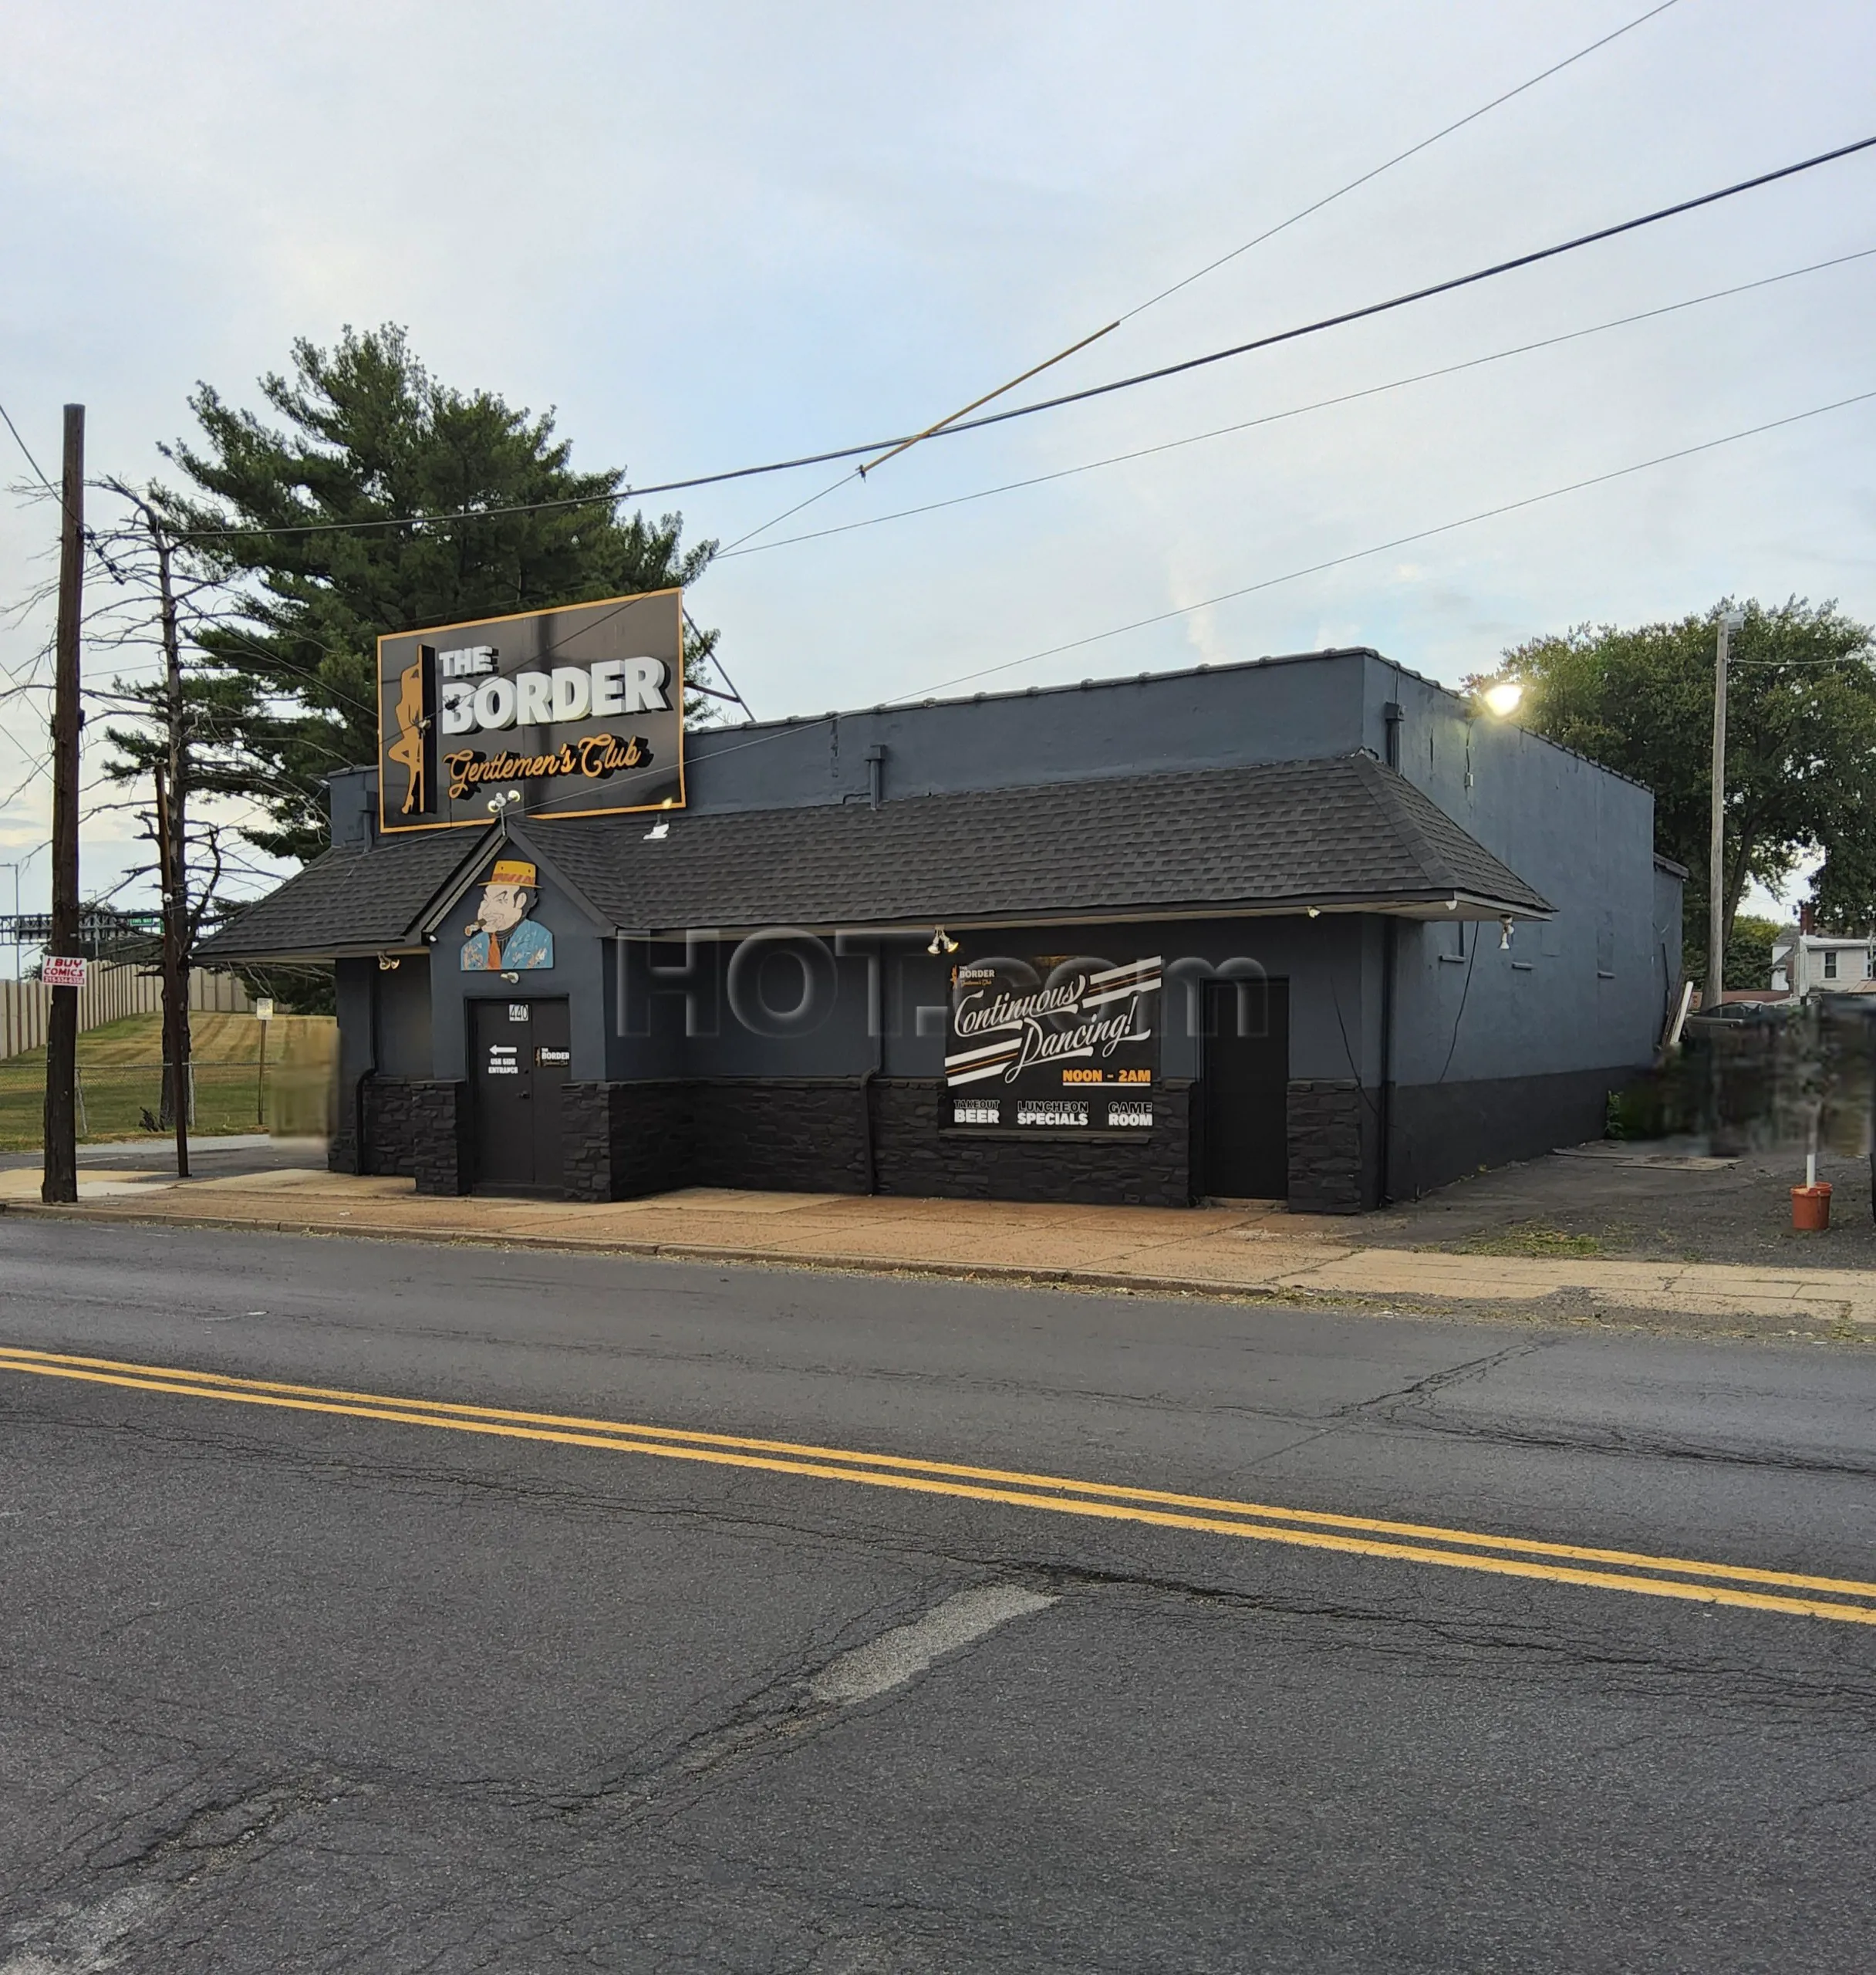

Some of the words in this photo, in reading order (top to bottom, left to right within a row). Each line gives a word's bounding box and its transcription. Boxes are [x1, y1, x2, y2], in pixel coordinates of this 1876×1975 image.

[438, 645, 493, 677] THE
[442, 657, 666, 734] BORDER
[443, 742, 576, 799] Gentlemen's
[578, 732, 643, 777] Club
[46, 957, 51, 967] I
[55, 958, 83, 967] BUY
[44, 967, 84, 977] COMICS
[959, 969, 995, 978] BORDER
[510, 1005, 528, 1019] 440
[955, 975, 1086, 1038] Continuous
[1005, 995, 1152, 1084] Dancing!
[542, 1052, 570, 1060] BORDER
[1063, 1069, 1103, 1082] NOON
[1119, 1069, 1152, 1082] 2AM
[953, 1099, 1000, 1109] TAKEOUT
[1017, 1101, 1089, 1113] LUNCHEON
[1108, 1102, 1153, 1114] GAME
[953, 1109, 1000, 1123] BEER
[1017, 1112, 1088, 1126] SPECIALS
[1108, 1113, 1153, 1126] ROOM
